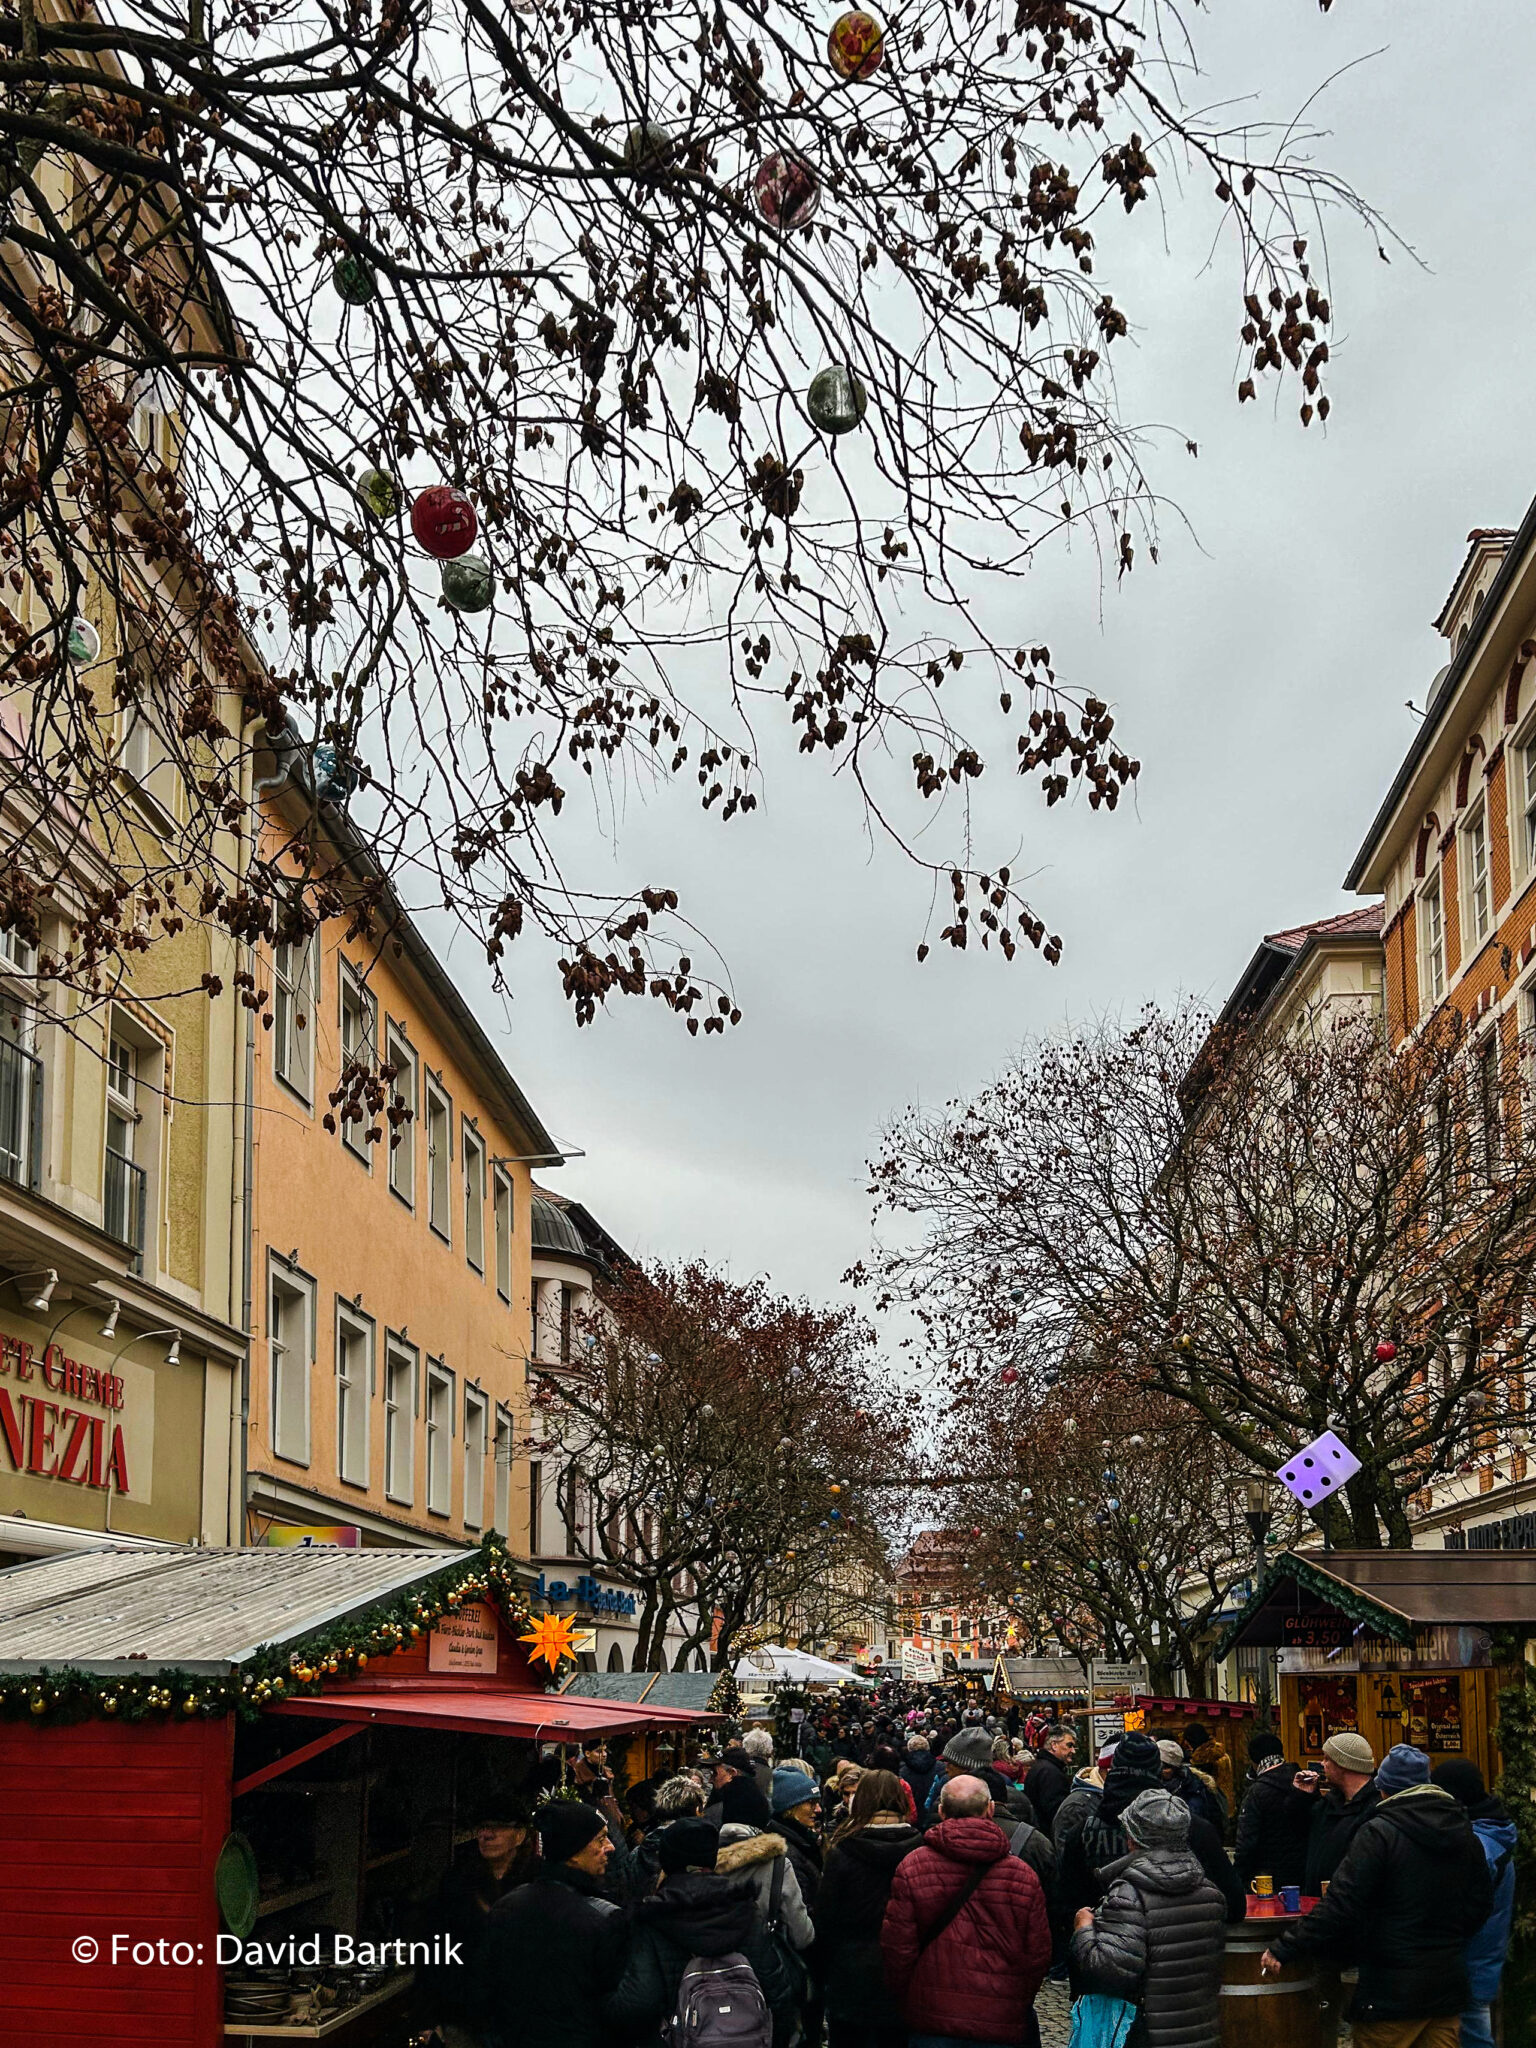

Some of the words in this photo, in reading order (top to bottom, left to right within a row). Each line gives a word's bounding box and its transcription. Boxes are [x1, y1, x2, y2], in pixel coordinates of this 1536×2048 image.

[1501, 1510, 1536, 1549] EXPR
[1285, 1617, 1350, 1630] GLÜHWEIN
[1306, 1631, 1340, 1646] 3,50
